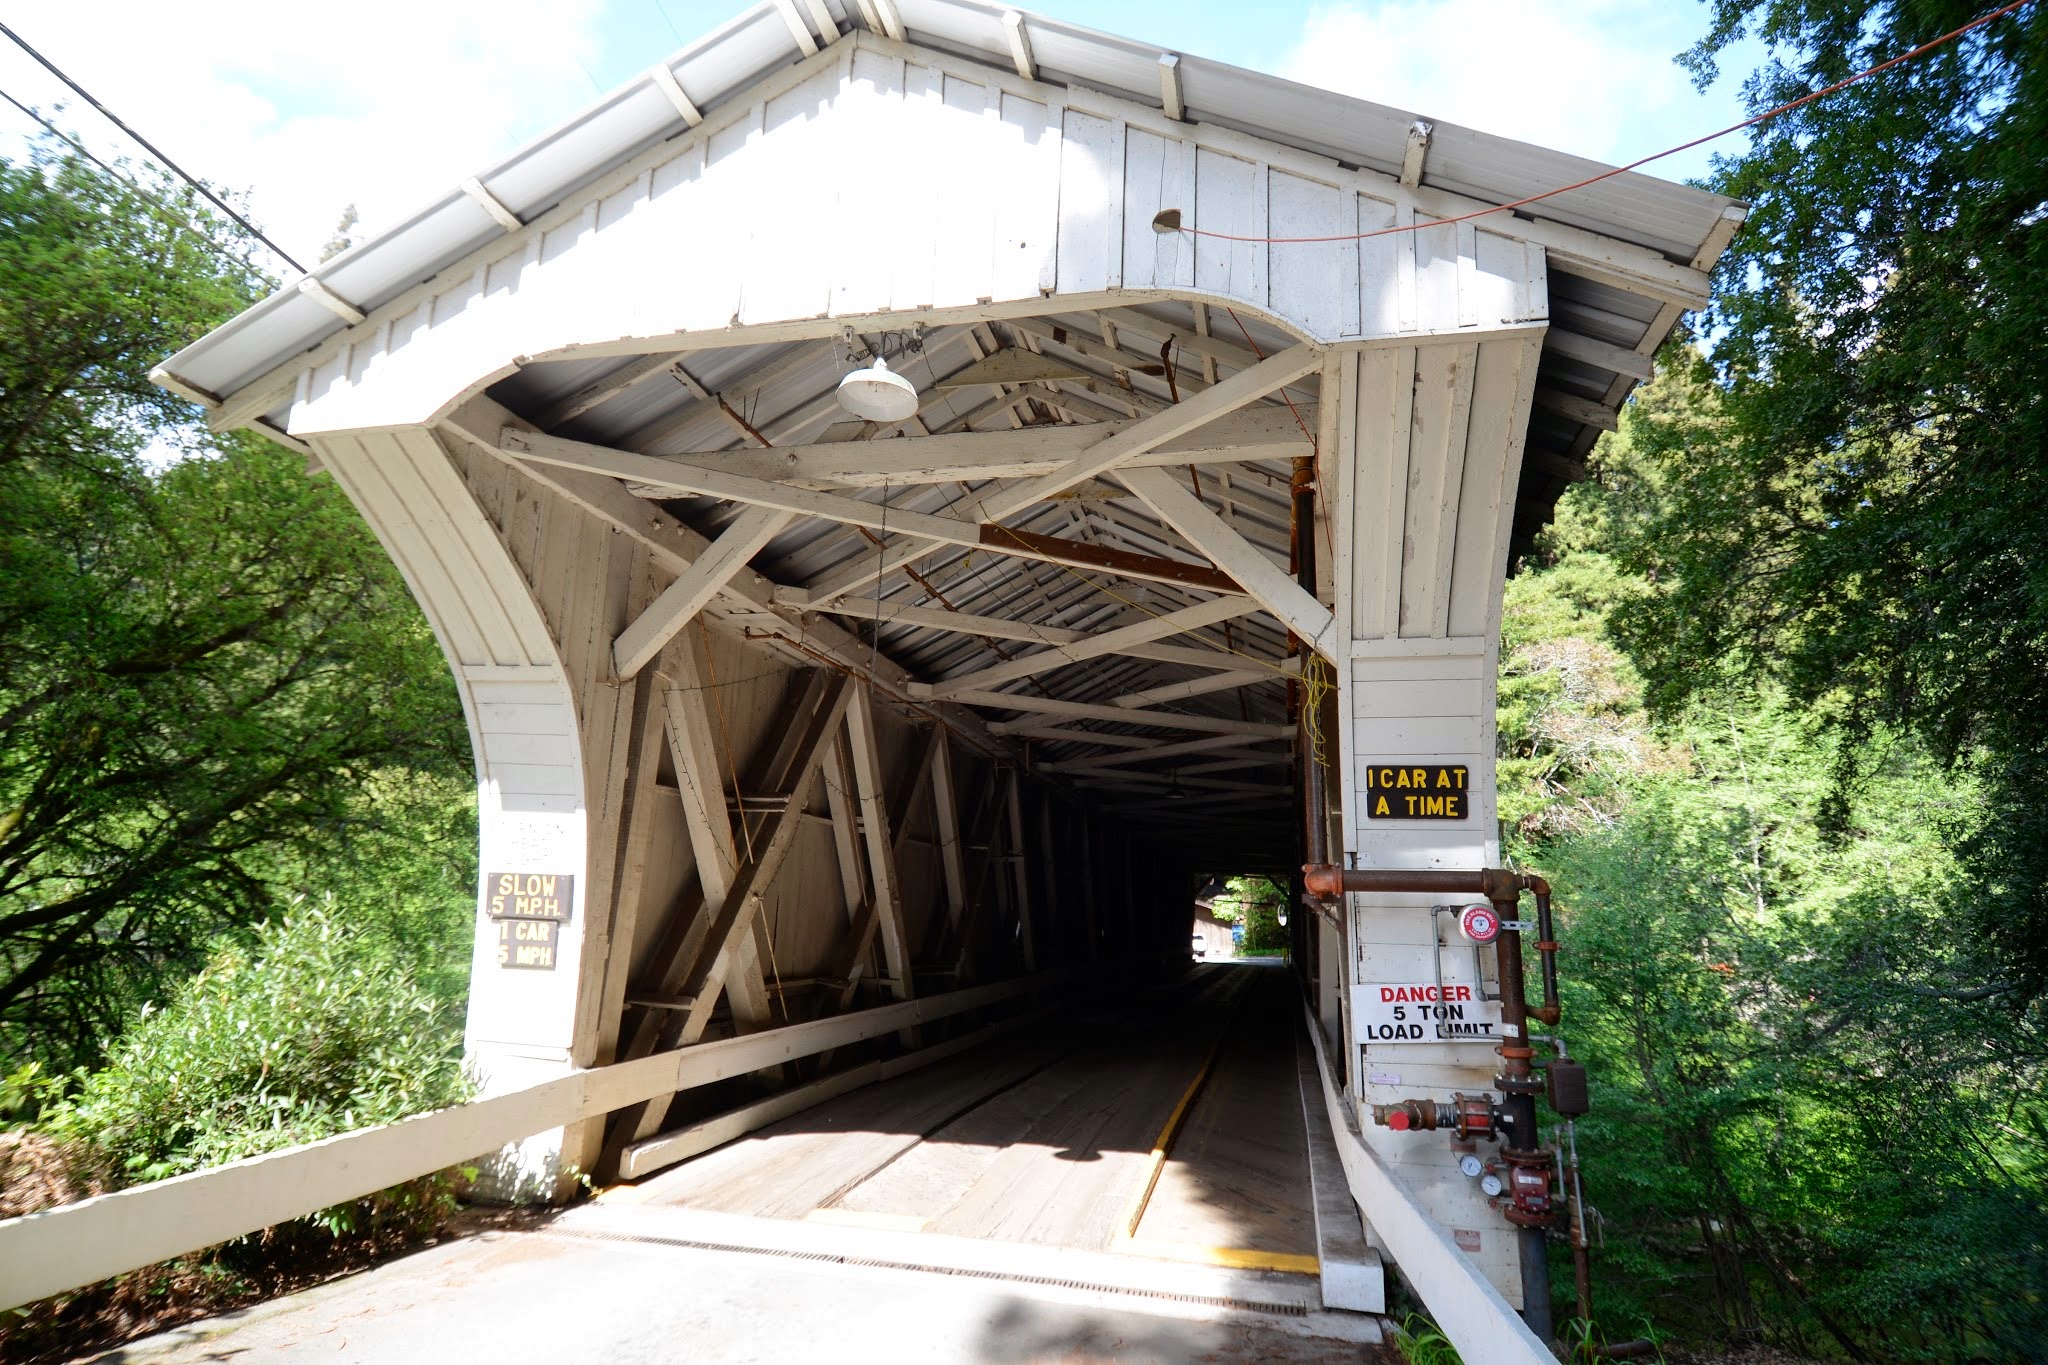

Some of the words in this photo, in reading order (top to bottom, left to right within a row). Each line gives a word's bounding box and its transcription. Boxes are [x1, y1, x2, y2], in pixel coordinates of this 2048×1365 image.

[1368, 768, 1374, 788] 1
[1380, 768, 1427, 789] CAR
[1437, 768, 1466, 789] AT
[1376, 795, 1390, 815] A
[1405, 795, 1459, 817] TIME
[499, 874, 556, 896] SLOW
[492, 896, 505, 914] 5
[500, 922, 508, 940] 1
[515, 922, 549, 941] CAR
[497, 945, 508, 964] 5
[1380, 986, 1471, 1003] DANGER
[1393, 1006, 1406, 1020] 5
[1418, 1005, 1464, 1020] TON
[1368, 1024, 1423, 1039] LOAD
